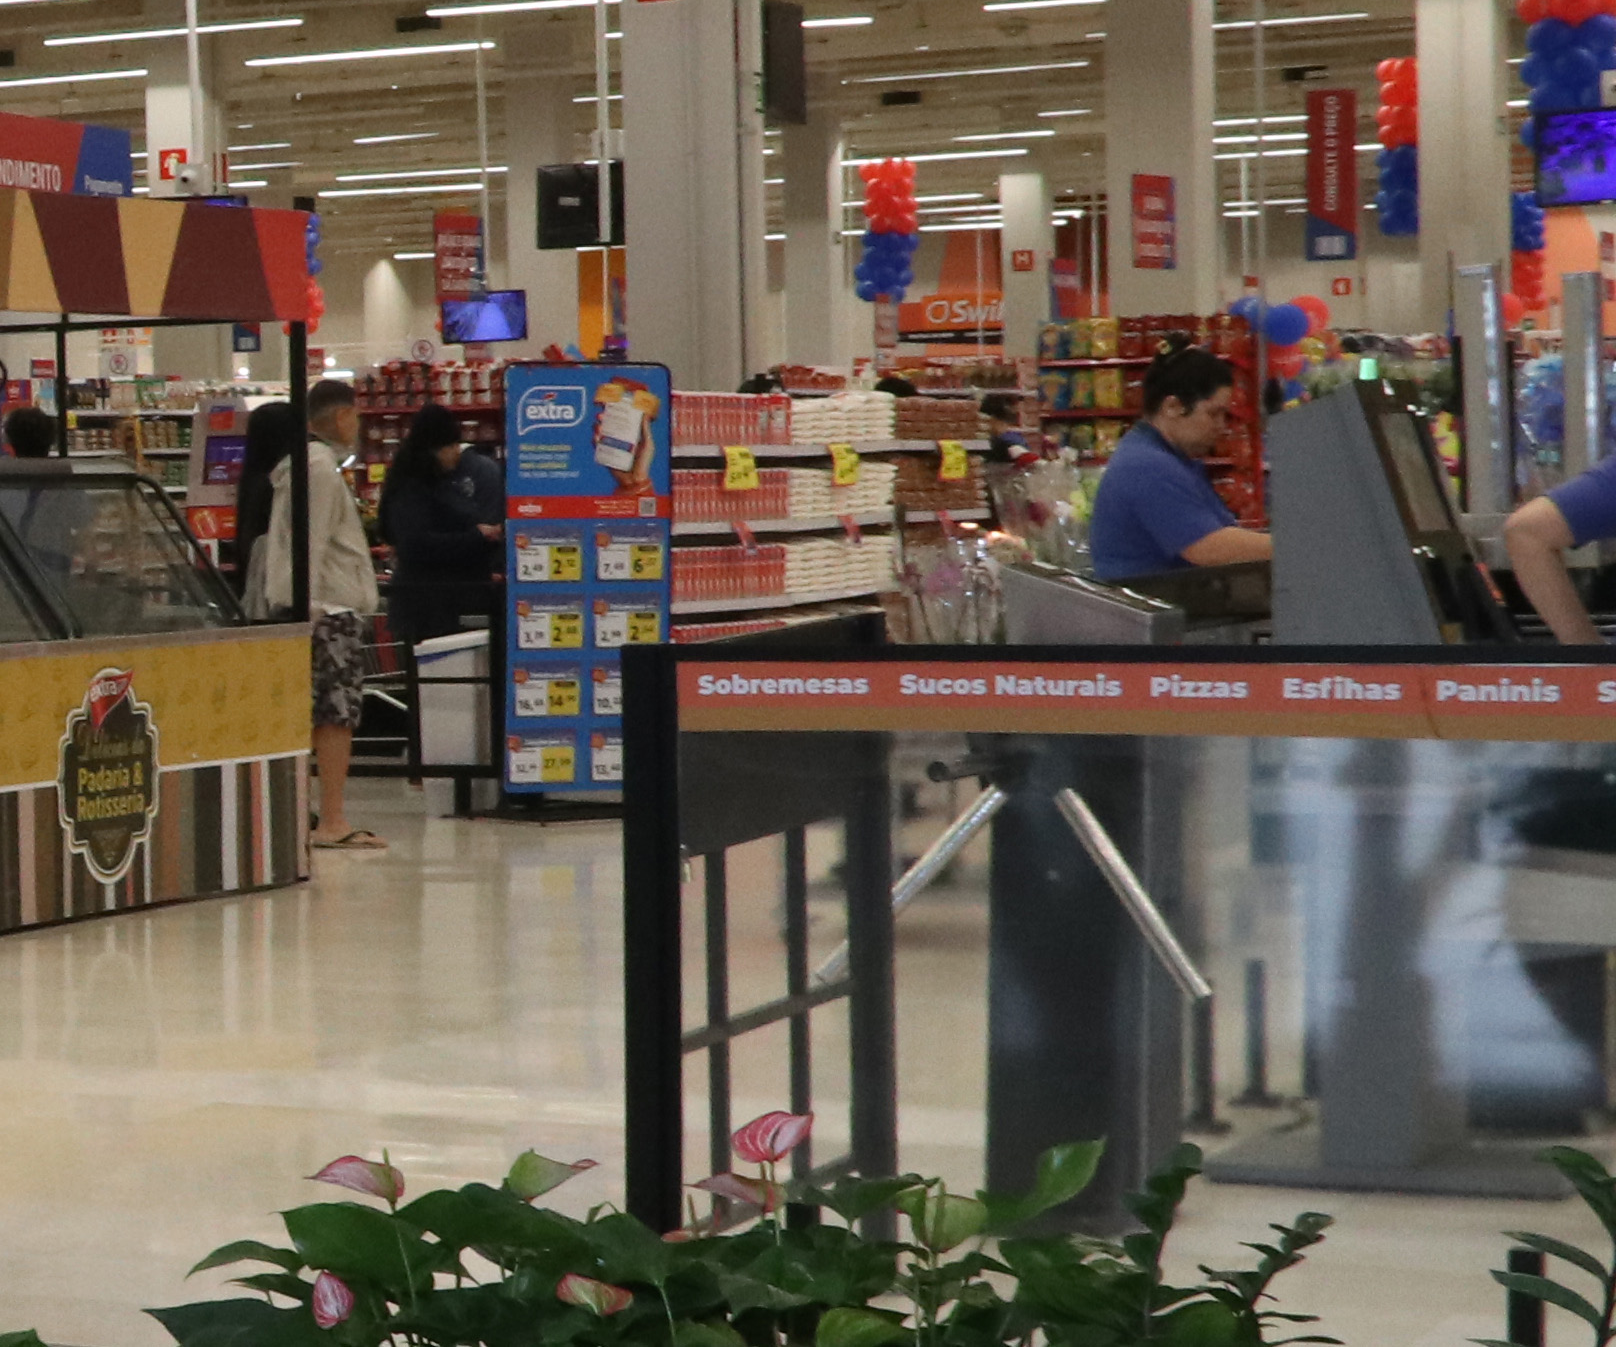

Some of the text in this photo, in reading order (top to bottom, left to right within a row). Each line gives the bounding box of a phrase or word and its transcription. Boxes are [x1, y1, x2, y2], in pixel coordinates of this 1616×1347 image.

[526, 403, 575, 420] extra
[90, 680, 119, 703] extra
[698, 674, 869, 695] Sobremesas
[899, 674, 1122, 697] Sucos Naturais
[1150, 676, 1248, 698] Pizzas
[1282, 675, 1402, 701] Esfihas
[1435, 677, 1561, 703] Paninis
[77, 764, 130, 795] Padaria
